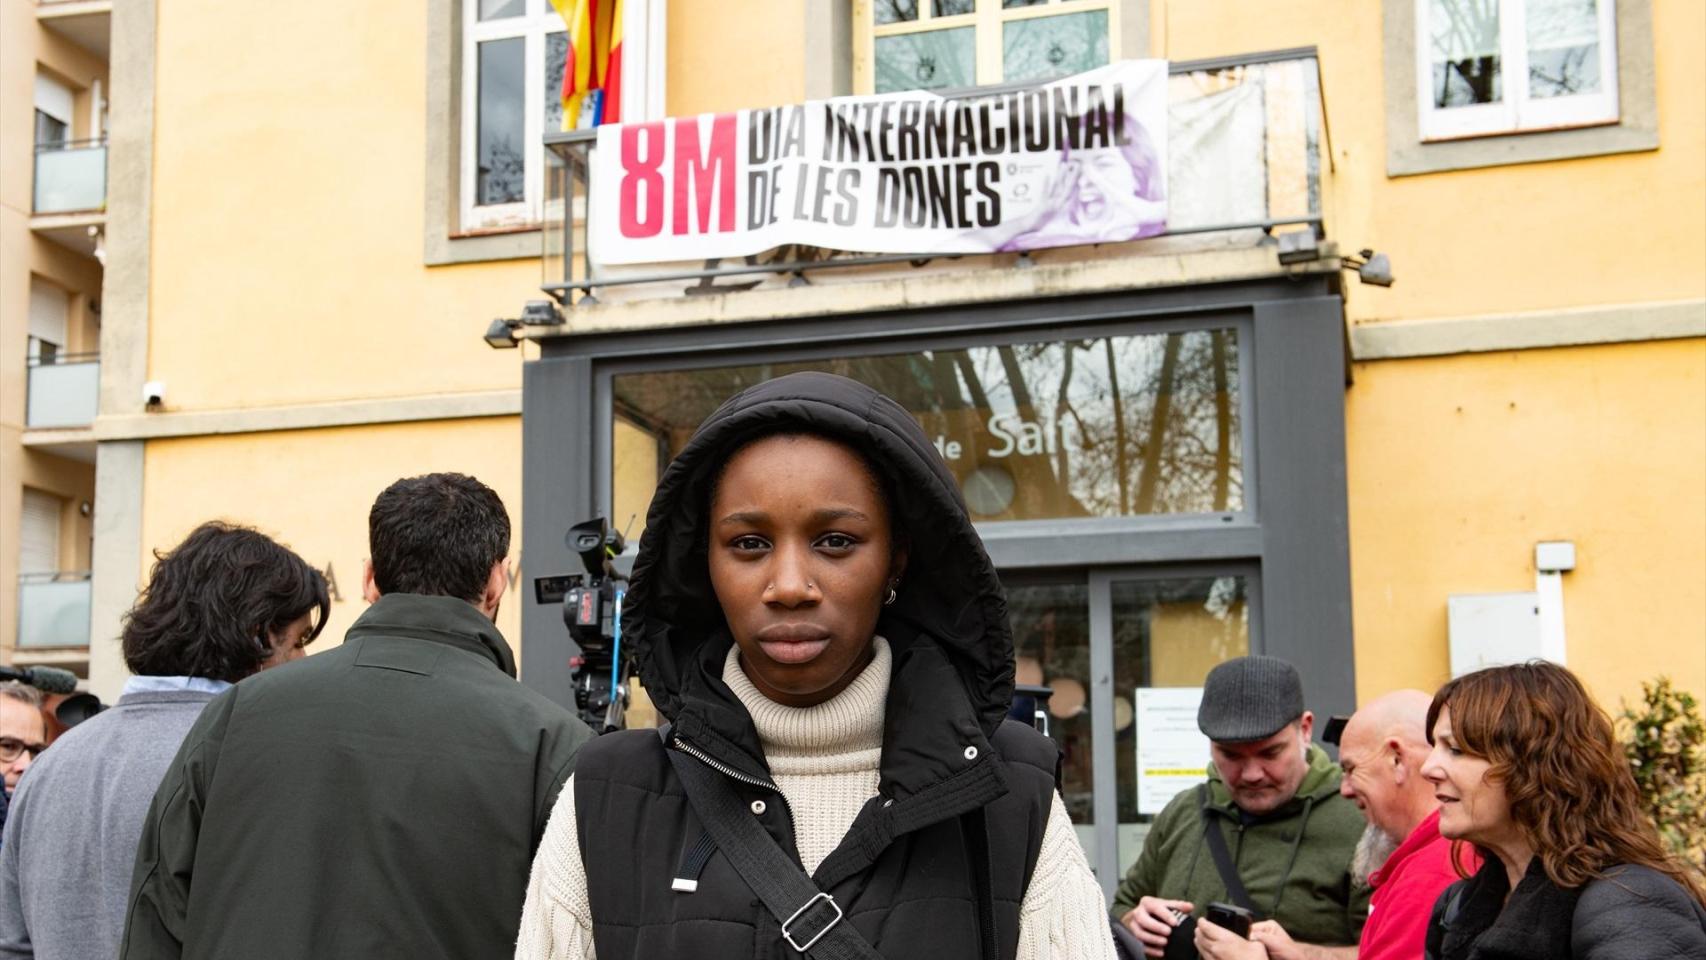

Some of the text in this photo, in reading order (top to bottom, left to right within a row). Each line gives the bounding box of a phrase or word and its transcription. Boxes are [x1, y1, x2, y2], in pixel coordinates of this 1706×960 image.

[748, 83, 1131, 165] DIA INTERNACIONAL
[619, 116, 737, 239] 8M
[747, 161, 1001, 232] DE LES DONES
[987, 413, 1078, 458] Salt
